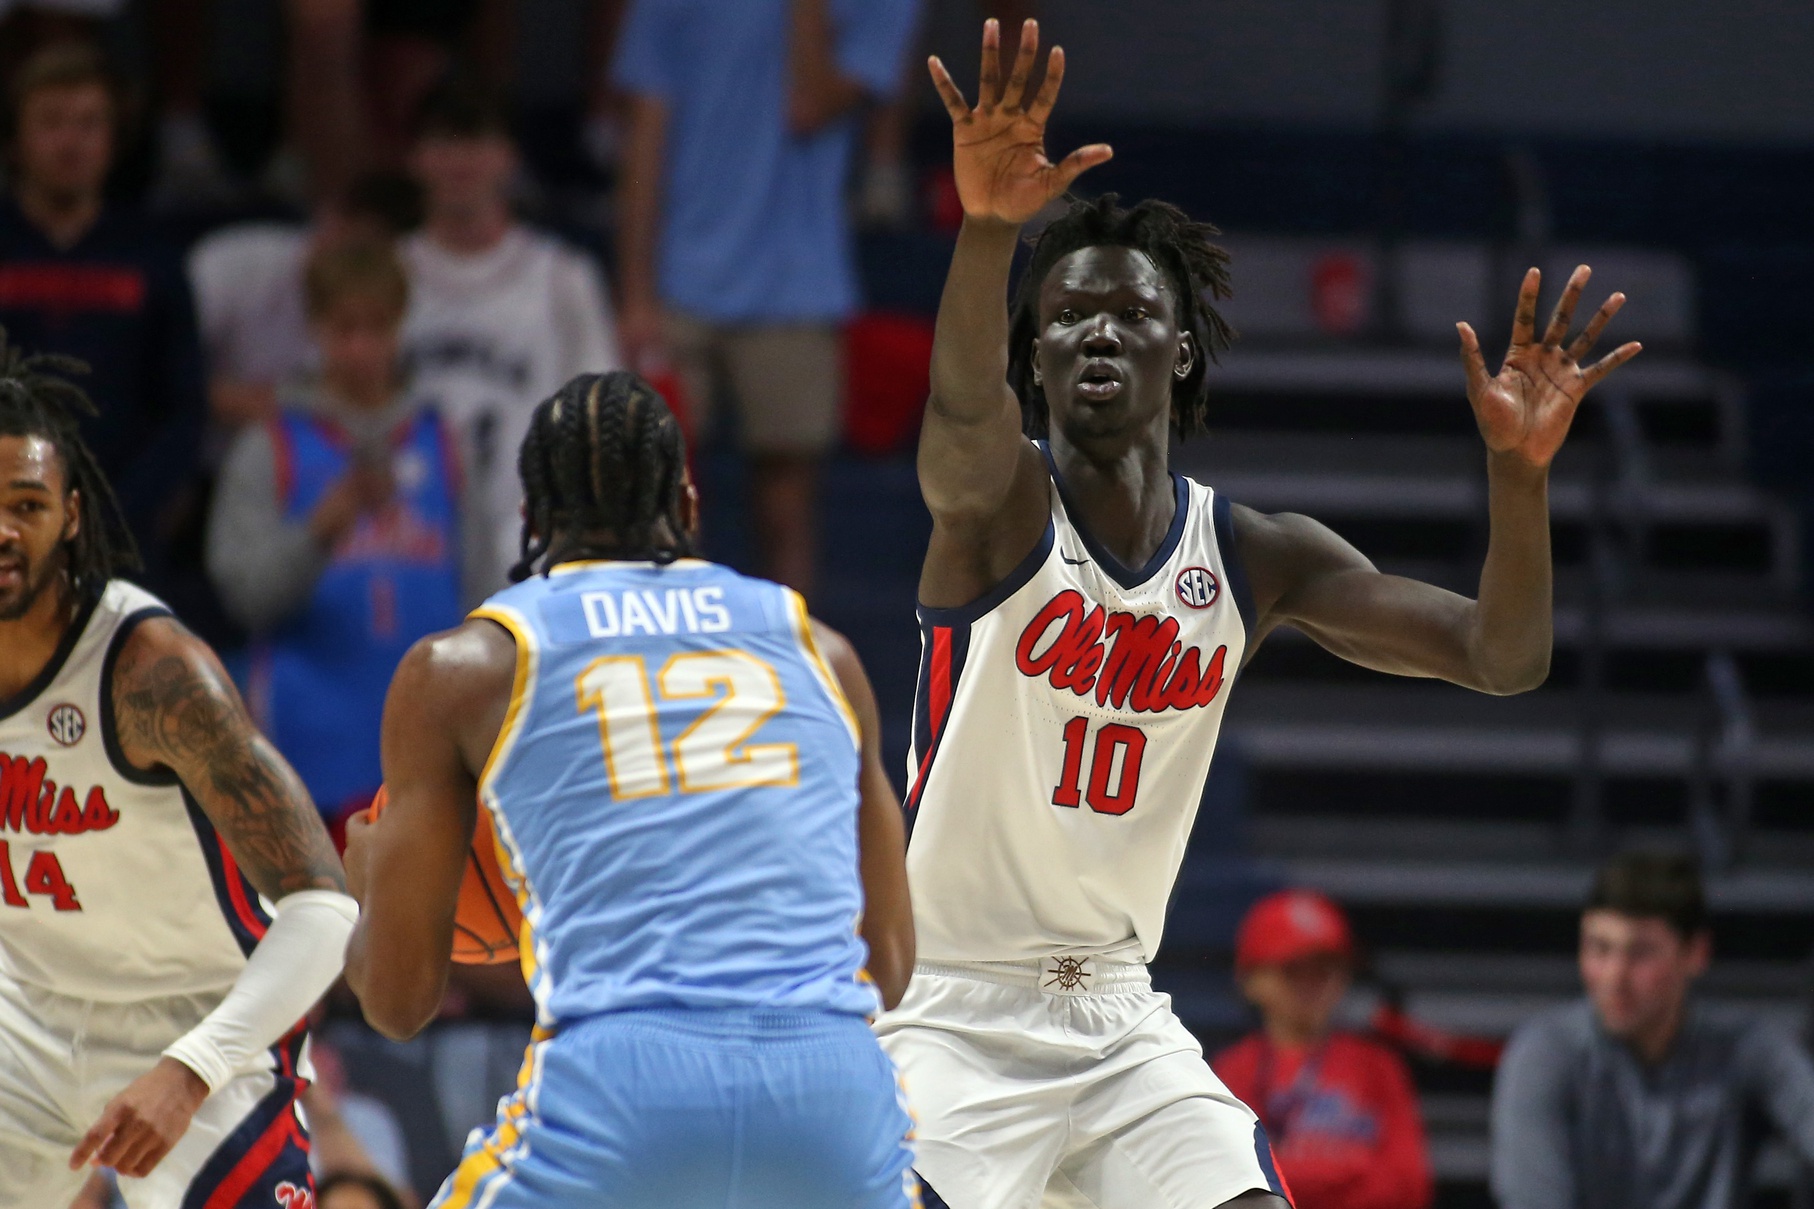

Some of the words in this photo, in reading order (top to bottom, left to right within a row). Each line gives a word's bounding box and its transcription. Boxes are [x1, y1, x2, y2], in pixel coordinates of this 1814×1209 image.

[580, 586, 732, 638] DAVIS
[1178, 569, 1217, 606] SEC
[1015, 589, 1105, 696] Ole
[1096, 611, 1227, 713] Miss
[50, 705, 84, 743] SEC
[575, 649, 799, 802] 12
[0, 752, 120, 835] Miss
[1052, 715, 1148, 816] 10
[0, 839, 83, 912] 14
